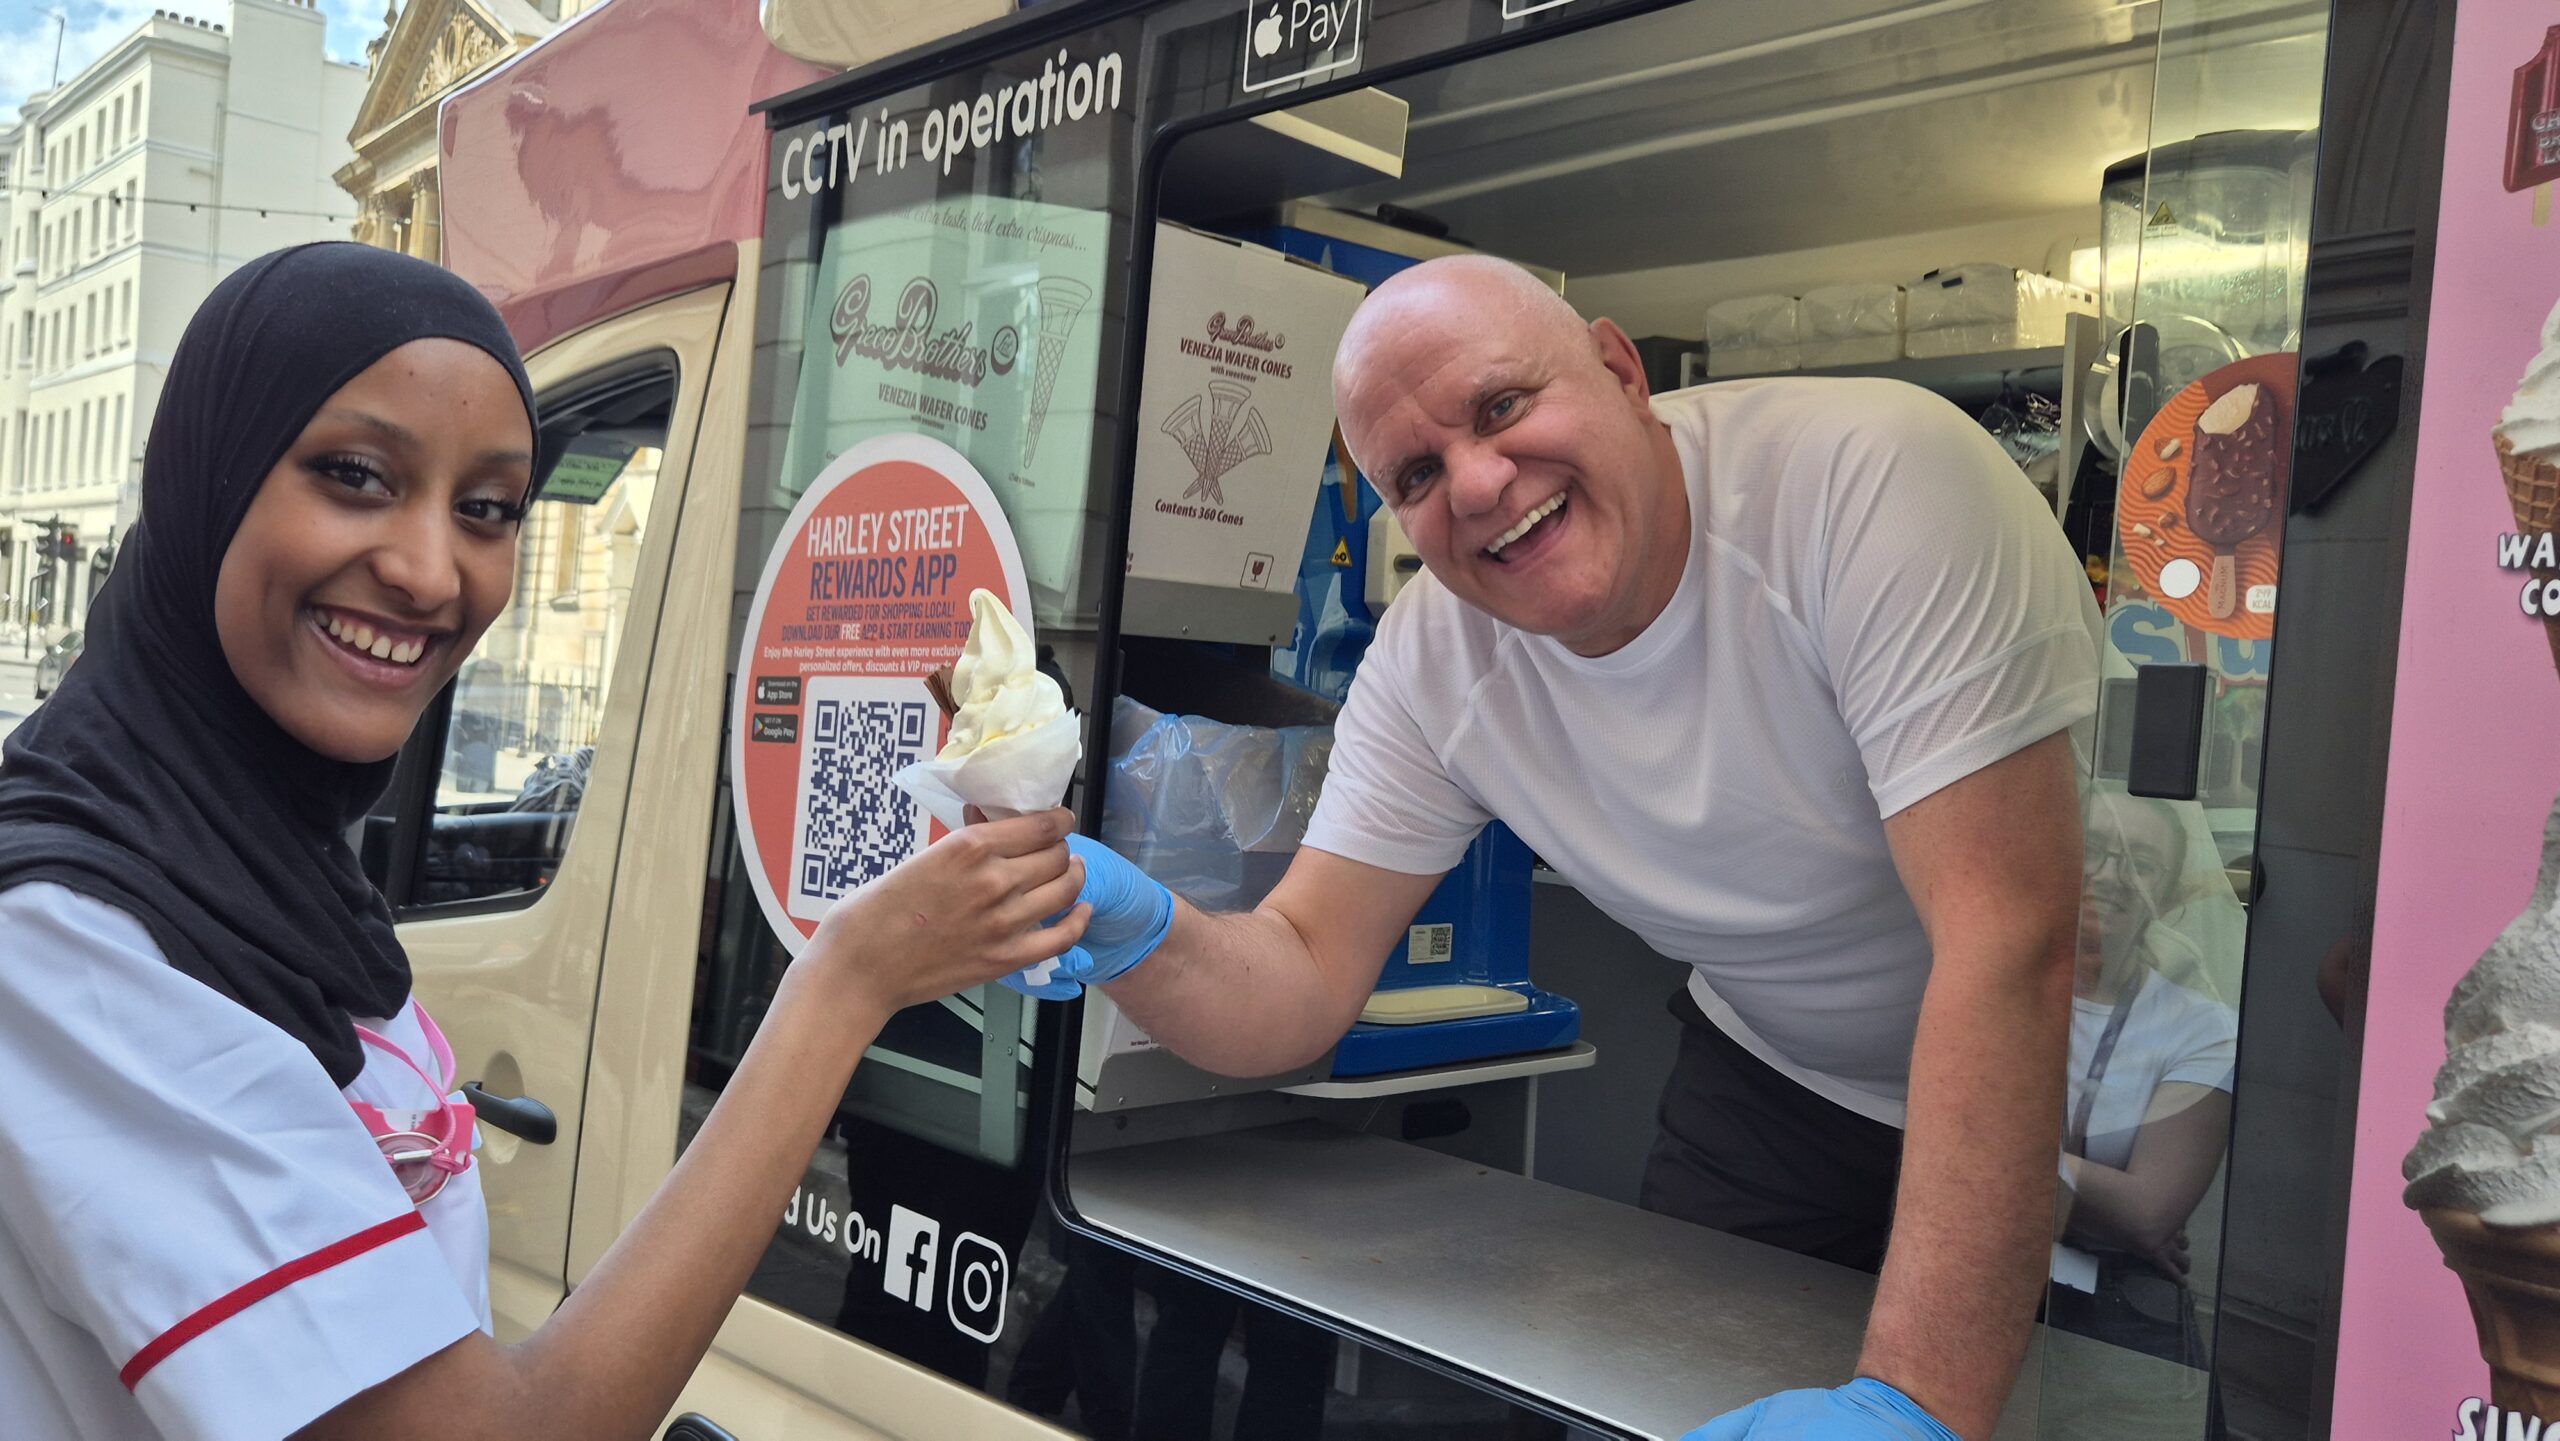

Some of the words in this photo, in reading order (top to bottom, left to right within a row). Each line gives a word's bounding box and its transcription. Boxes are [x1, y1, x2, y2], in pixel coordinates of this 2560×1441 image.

[1289, 0, 1343, 51] Pay
[781, 117, 868, 200] CCTV
[877, 107, 909, 176] in
[921, 48, 1123, 176] operation
[971, 211, 993, 234] that
[996, 219, 1023, 240] extra
[1180, 337, 1222, 362] VENEZIA
[1224, 349, 1259, 372] WAFER
[1261, 358, 1293, 379] CONES
[1210, 365, 1225, 376] with
[878, 383, 917, 411] VENEZIA
[919, 394, 953, 421] WAFER
[954, 406, 988, 431] CONES
[1154, 498, 1197, 520] Contents
[1197, 506, 1216, 523] 360
[1216, 510, 1244, 527] Cones
[807, 512, 883, 558] HARLEY
[887, 503, 969, 551] STREET
[2498, 532, 2560, 568] WA
[810, 554, 907, 601] REWARDS
[911, 554, 957, 597] APP
[806, 605, 820, 621] GET
[821, 604, 863, 621] REWARDED
[865, 603, 881, 619] FOR
[882, 602, 923, 619] SHOPPING
[924, 601, 955, 618] LOCAL!
[783, 624, 823, 641] DOWNLOAD
[824, 623, 840, 640] OUR
[841, 623, 860, 640] FREE
[863, 623, 878, 640] APP
[886, 623, 913, 640] START
[914, 621, 951, 639] EARNING
[764, 646, 780, 660] Enjoy
[782, 646, 793, 657] the
[794, 646, 814, 659] Harley
[815, 646, 835, 657] Street
[836, 646, 873, 659] experience
[875, 645, 890, 657] with
[892, 646, 909, 657] even
[910, 646, 929, 657] more
[799, 660, 841, 673] personalized
[866, 660, 899, 673] discounts
[907, 660, 920, 672] VIP
[767, 690, 778, 702] App
[779, 689, 793, 699] Store
[764, 726, 783, 739] Google
[783, 727, 796, 739] Play
[806, 1192, 838, 1243] Us
[844, 1211, 881, 1263] On
